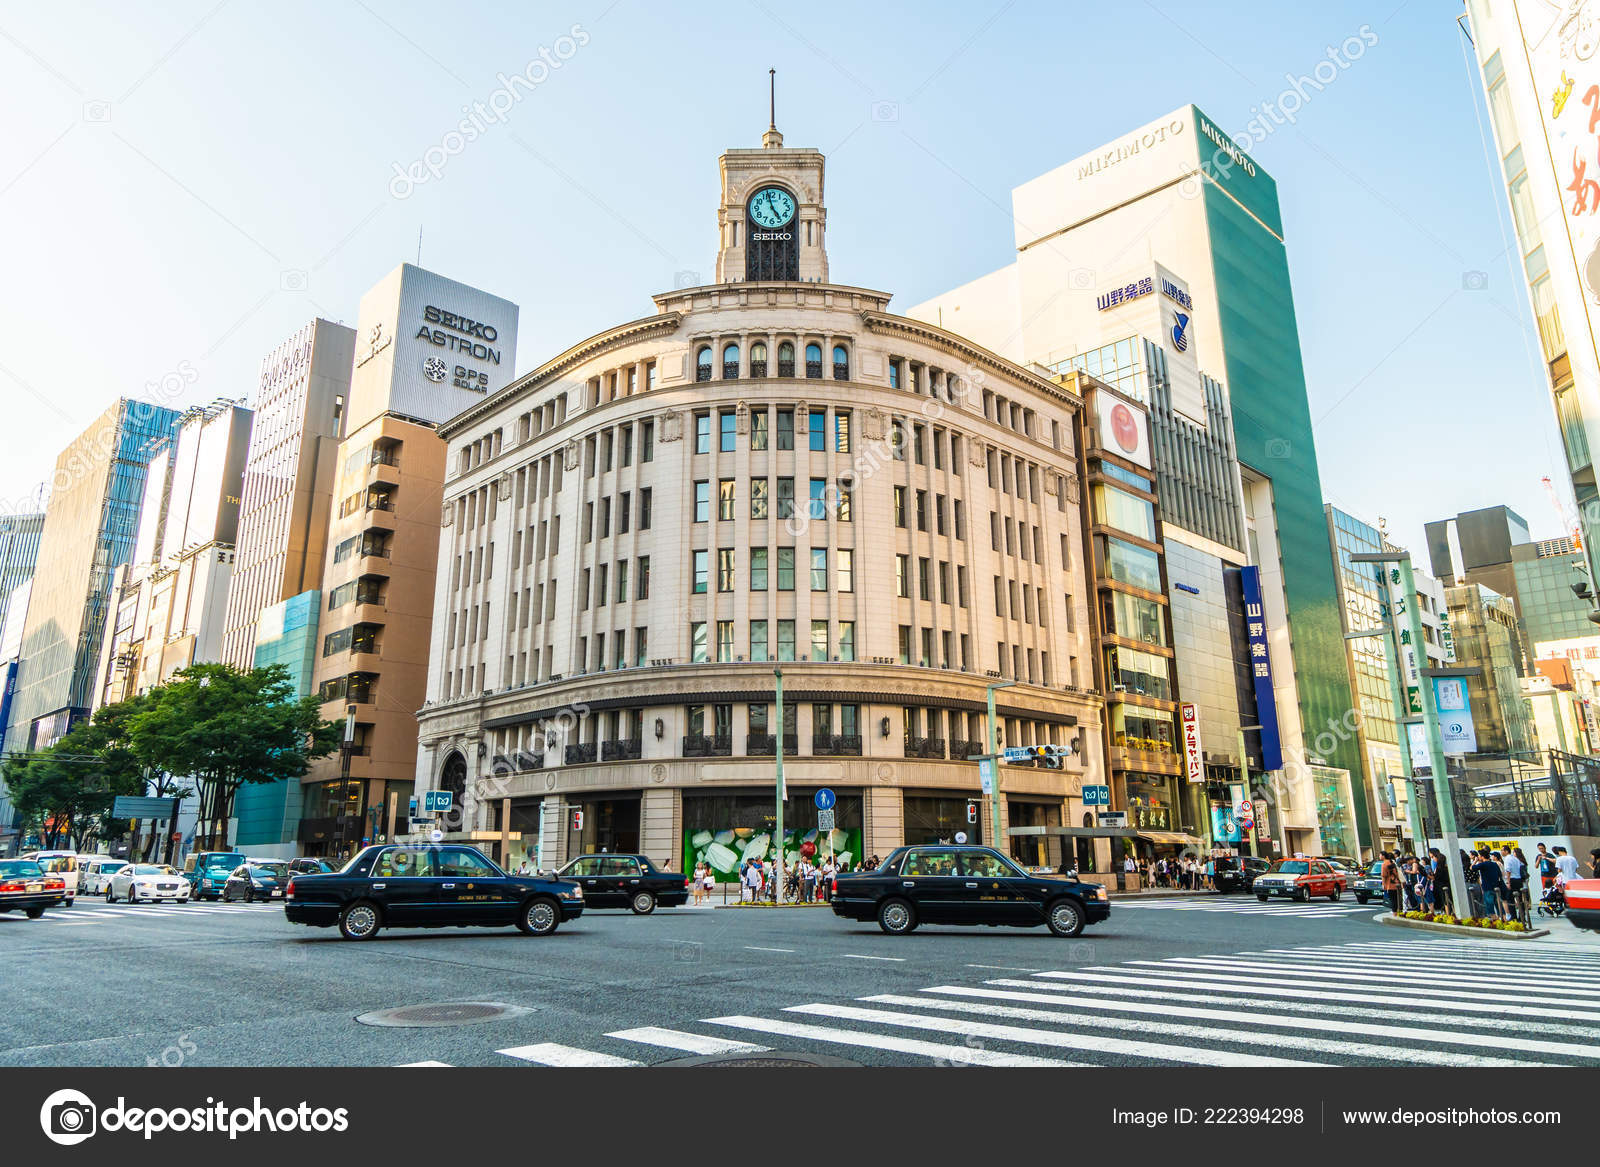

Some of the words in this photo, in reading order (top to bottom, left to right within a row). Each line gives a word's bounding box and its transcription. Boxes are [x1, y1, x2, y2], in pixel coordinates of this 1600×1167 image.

[1077, 119, 1185, 181] MIKIMOTO
[1200, 118, 1257, 179] MIKIMOTO
[753, 232, 792, 241] SEIKO
[1096, 276, 1153, 312] 山野楽器
[1161, 276, 1194, 312] 山野楽器
[424, 304, 498, 343] SEIKO
[416, 326, 501, 366] ASTRON
[453, 379, 488, 395] SOLAR
[454, 364, 489, 386] GPS
[226, 495, 240, 505] TH
[1246, 603, 1269, 678] 山野楽器
[1186, 724, 1200, 779] キムラヤのパン
